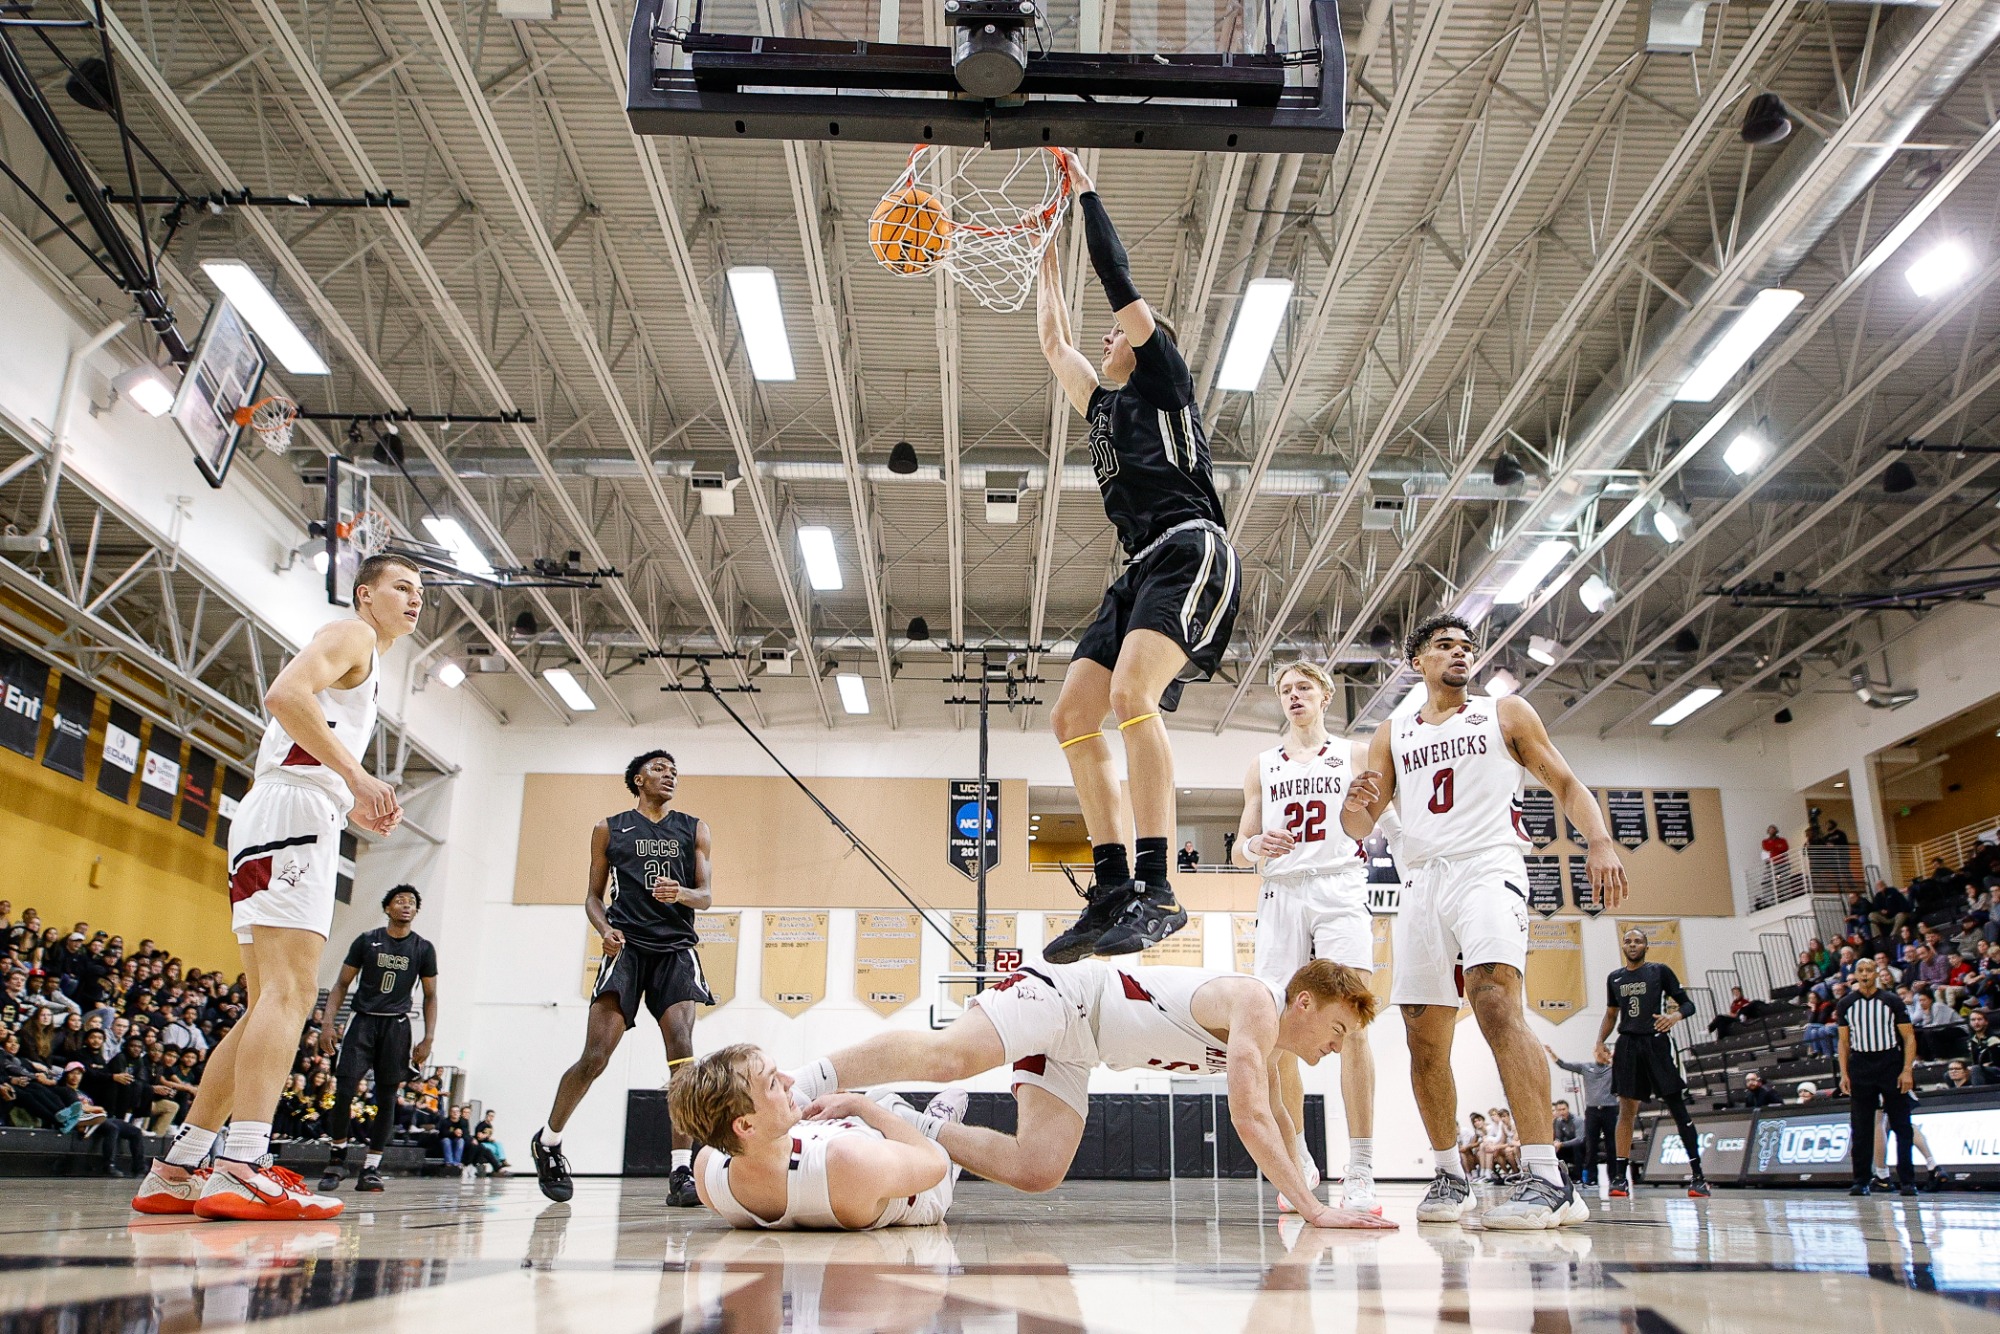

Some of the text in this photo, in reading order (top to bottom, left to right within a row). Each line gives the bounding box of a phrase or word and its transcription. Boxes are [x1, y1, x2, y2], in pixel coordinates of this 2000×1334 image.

[4, 684, 42, 721] Ent
[1402, 734, 1487, 775] MAVERICKS
[1270, 777, 1341, 802] MAVERICKS
[1428, 768, 1454, 814] 0
[960, 818, 992, 829] NCA
[1284, 800, 1327, 843] 22
[635, 839, 680, 858] UCCS
[961, 848, 981, 857] 201
[644, 860, 671, 890] 21
[377, 953, 409, 971] UCCS
[996, 952, 1020, 972] 22
[381, 971, 397, 994] 0
[1619, 981, 1647, 997] UCCS
[775, 992, 812, 1003] UCCS
[868, 992, 905, 1003] UCCS
[1628, 996, 1640, 1018] 3
[1716, 1138, 1746, 1152] UCCS
[1780, 1124, 1851, 1163] UCCS
[1961, 1138, 2000, 1156] NILL
